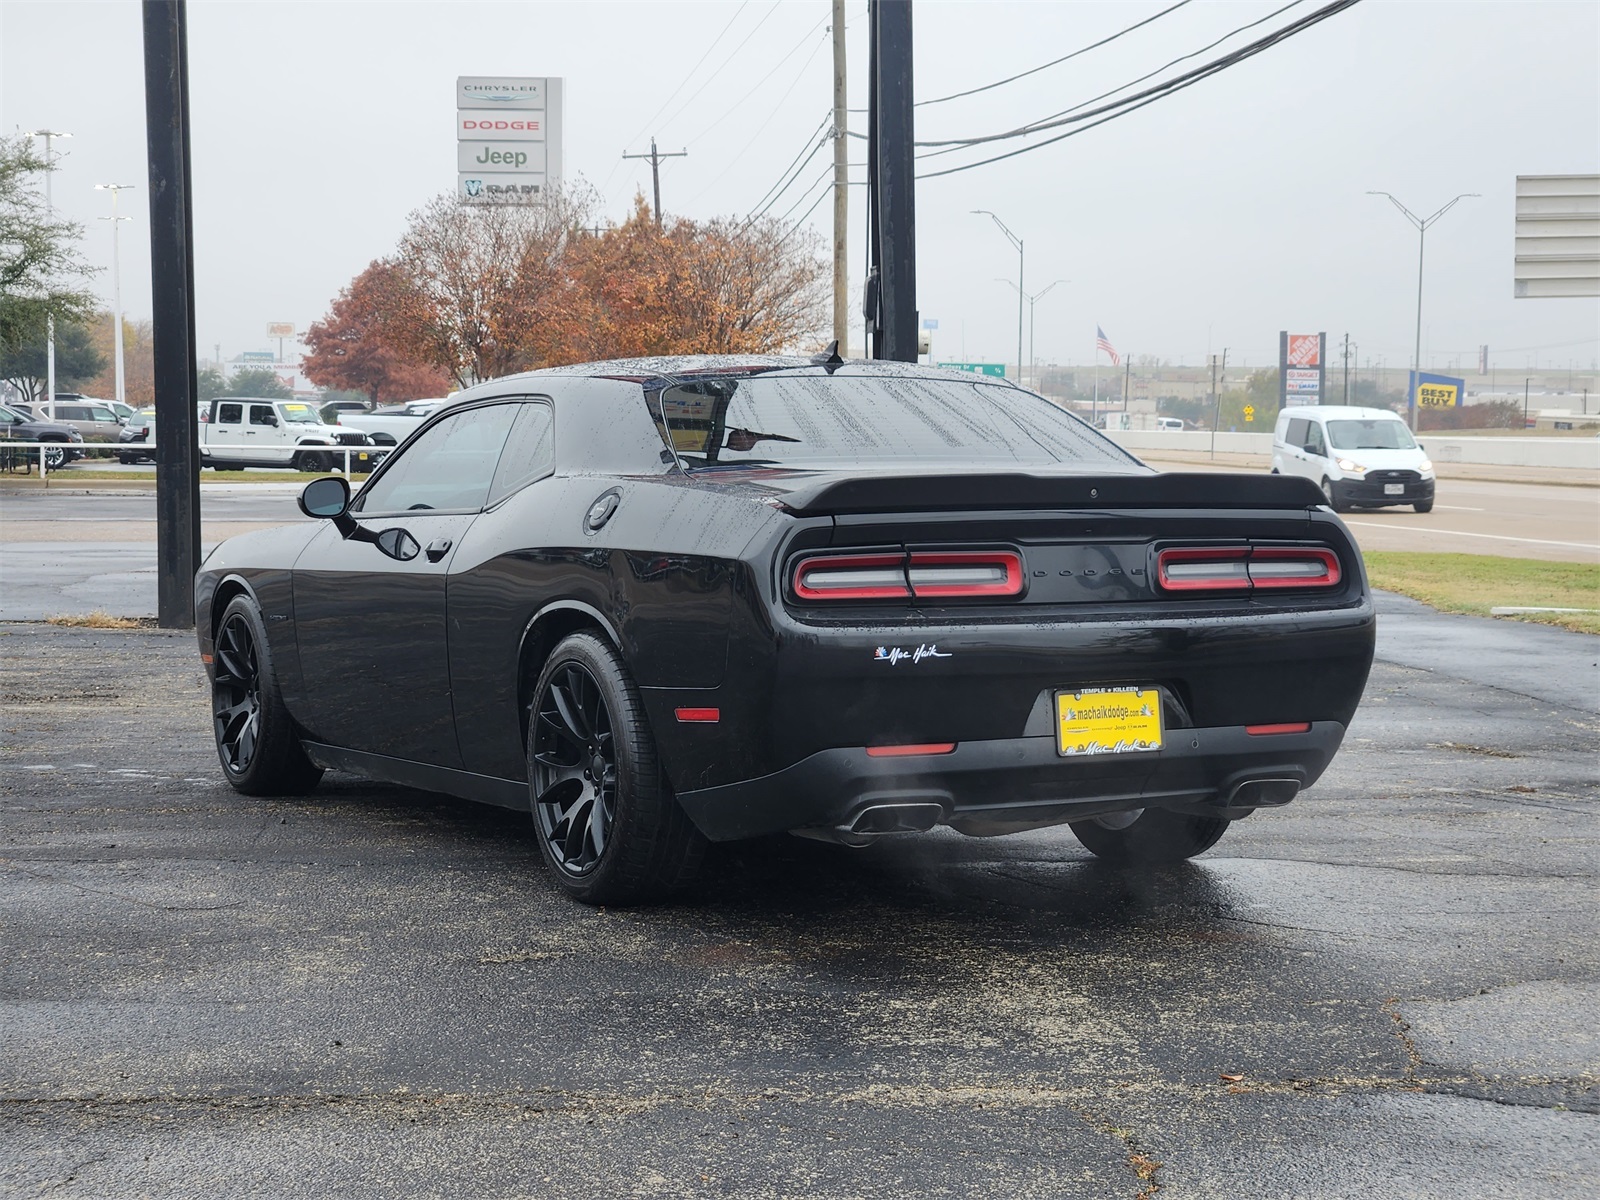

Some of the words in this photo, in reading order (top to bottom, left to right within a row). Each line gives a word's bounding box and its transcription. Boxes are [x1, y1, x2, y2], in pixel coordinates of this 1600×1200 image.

[463, 121, 540, 130] DODGE
[476, 147, 527, 168] Jeep
[486, 184, 540, 194] RAM
[1421, 388, 1454, 398] BEST
[1421, 397, 1451, 406] BUY
[1033, 568, 1144, 577] DODGE
[887, 647, 911, 665] Mac
[913, 643, 945, 664] Haik
[1077, 704, 1140, 720] machaikdodge.com
[1085, 741, 1112, 755] Mac
[1113, 739, 1142, 754] Haik
